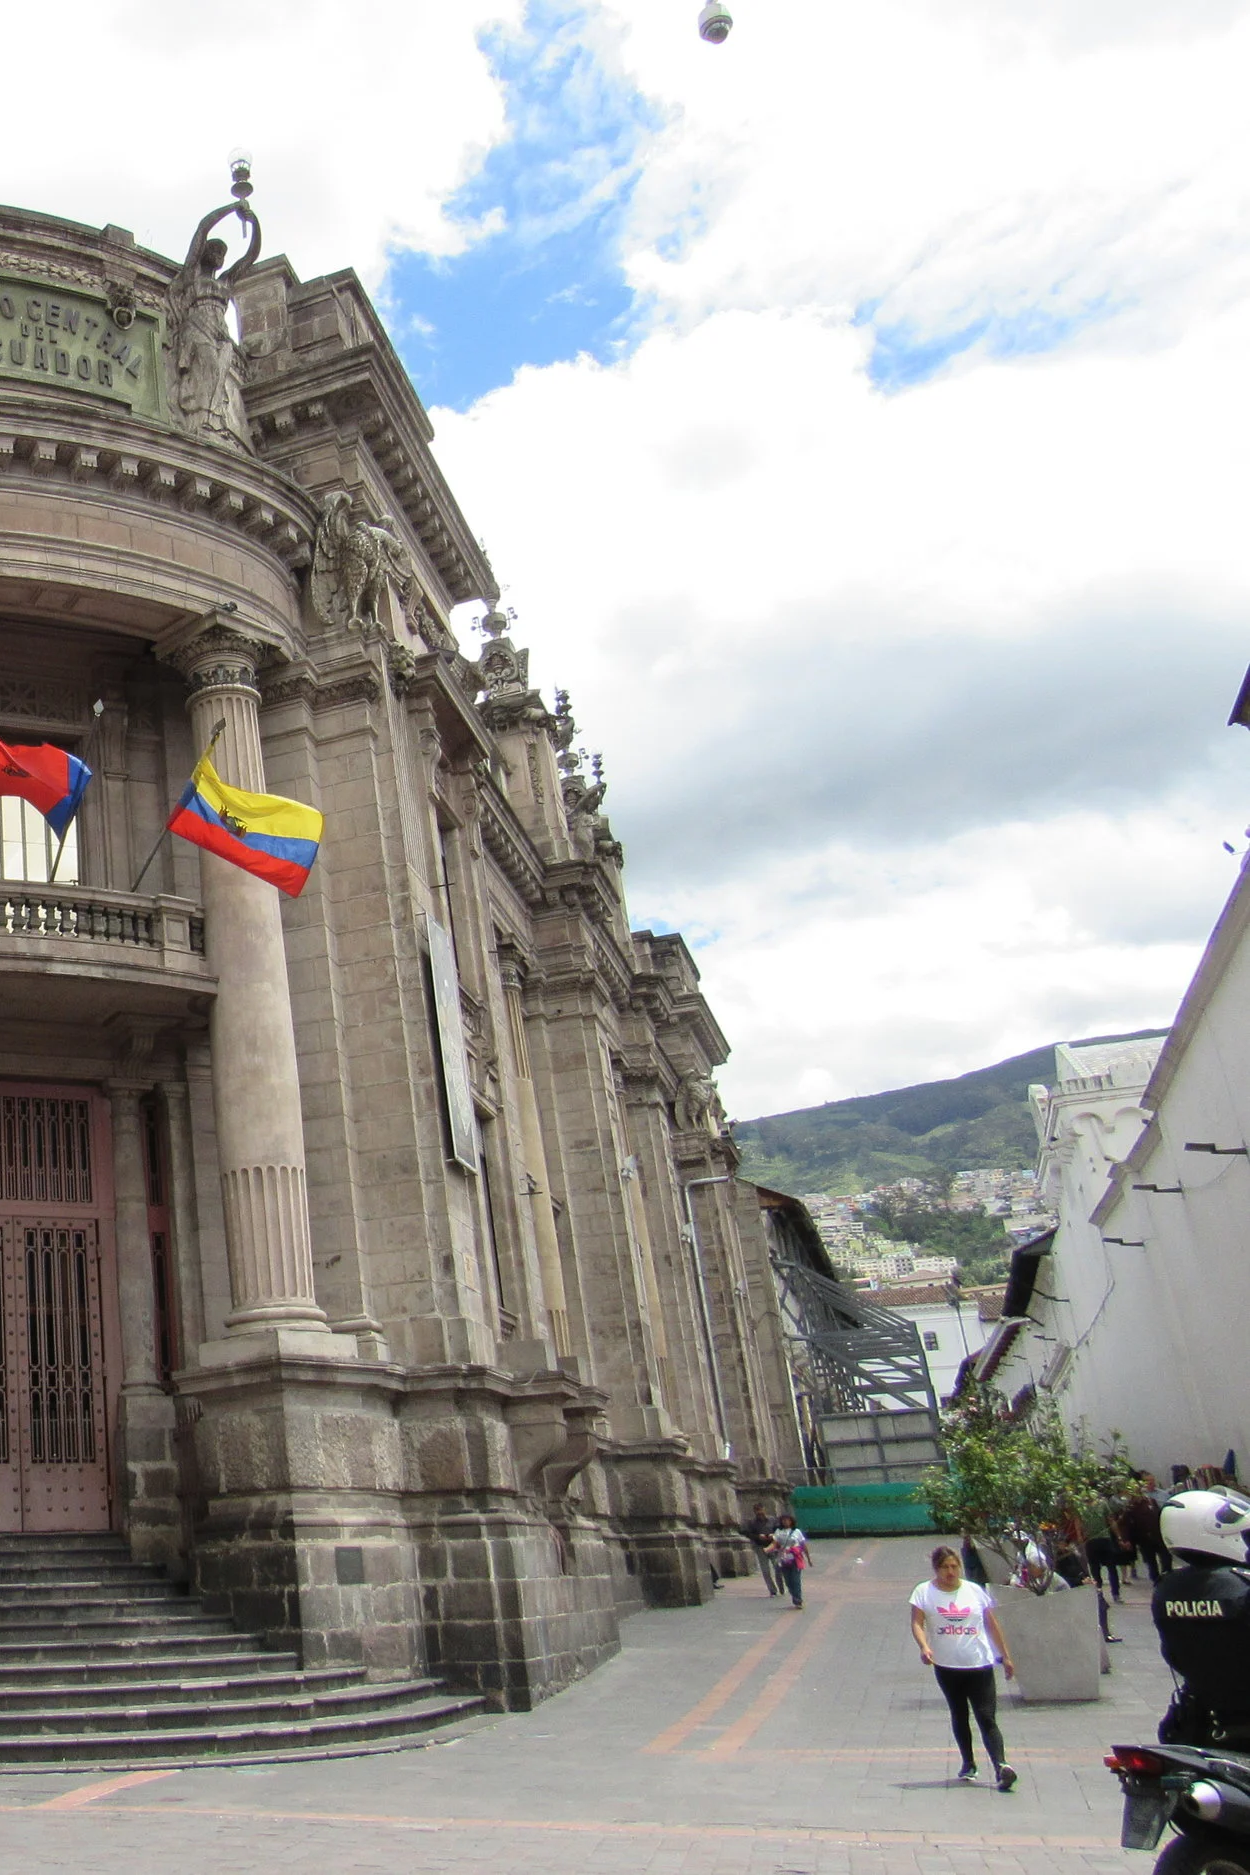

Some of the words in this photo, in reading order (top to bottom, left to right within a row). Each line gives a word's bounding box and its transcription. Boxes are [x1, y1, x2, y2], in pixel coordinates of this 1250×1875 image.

[20, 321, 58, 344] DEL
[26, 299, 143, 379] CENTRAL
[1165, 1600, 1223, 1617] POLICIA
[937, 1624, 977, 1635] adidas
